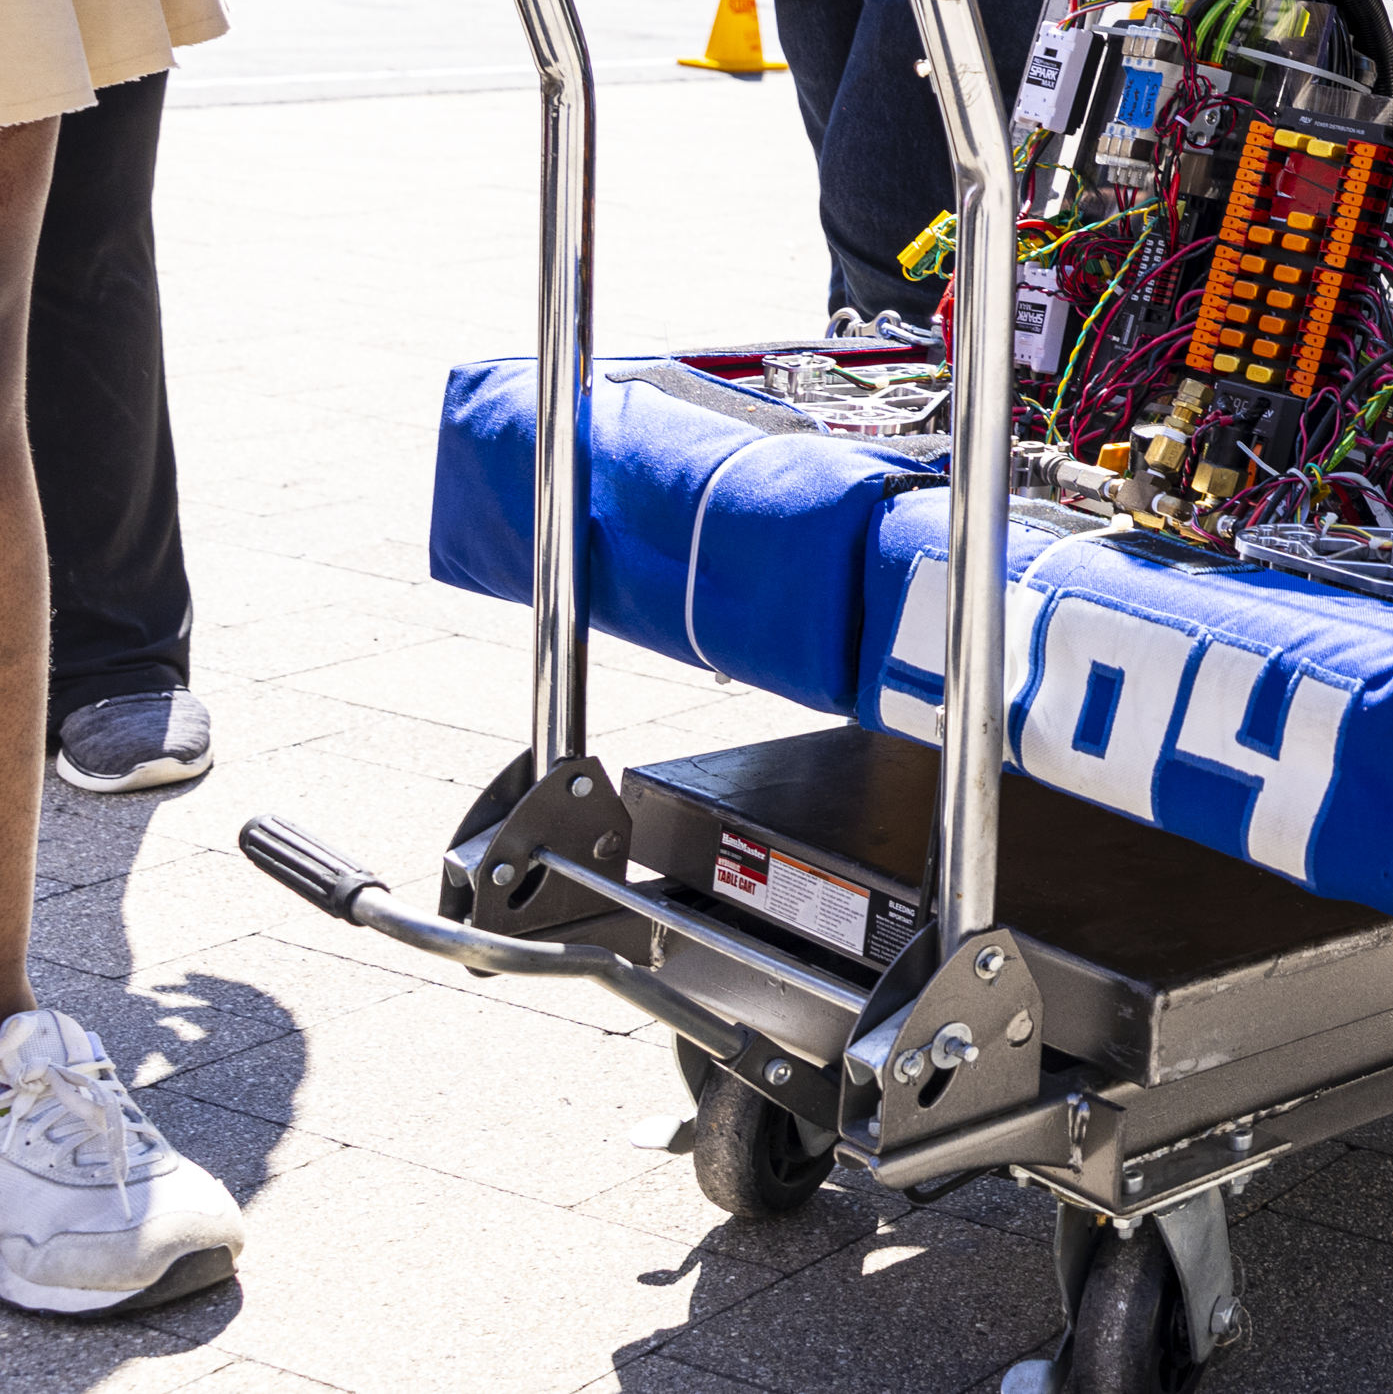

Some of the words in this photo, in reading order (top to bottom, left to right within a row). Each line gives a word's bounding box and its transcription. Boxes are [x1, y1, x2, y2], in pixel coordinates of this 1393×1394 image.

[1029, 66, 1059, 81] SPARK
[1016, 310, 1045, 325] SPARK
[717, 868, 738, 888] TABLE
[739, 877, 757, 896] CART
